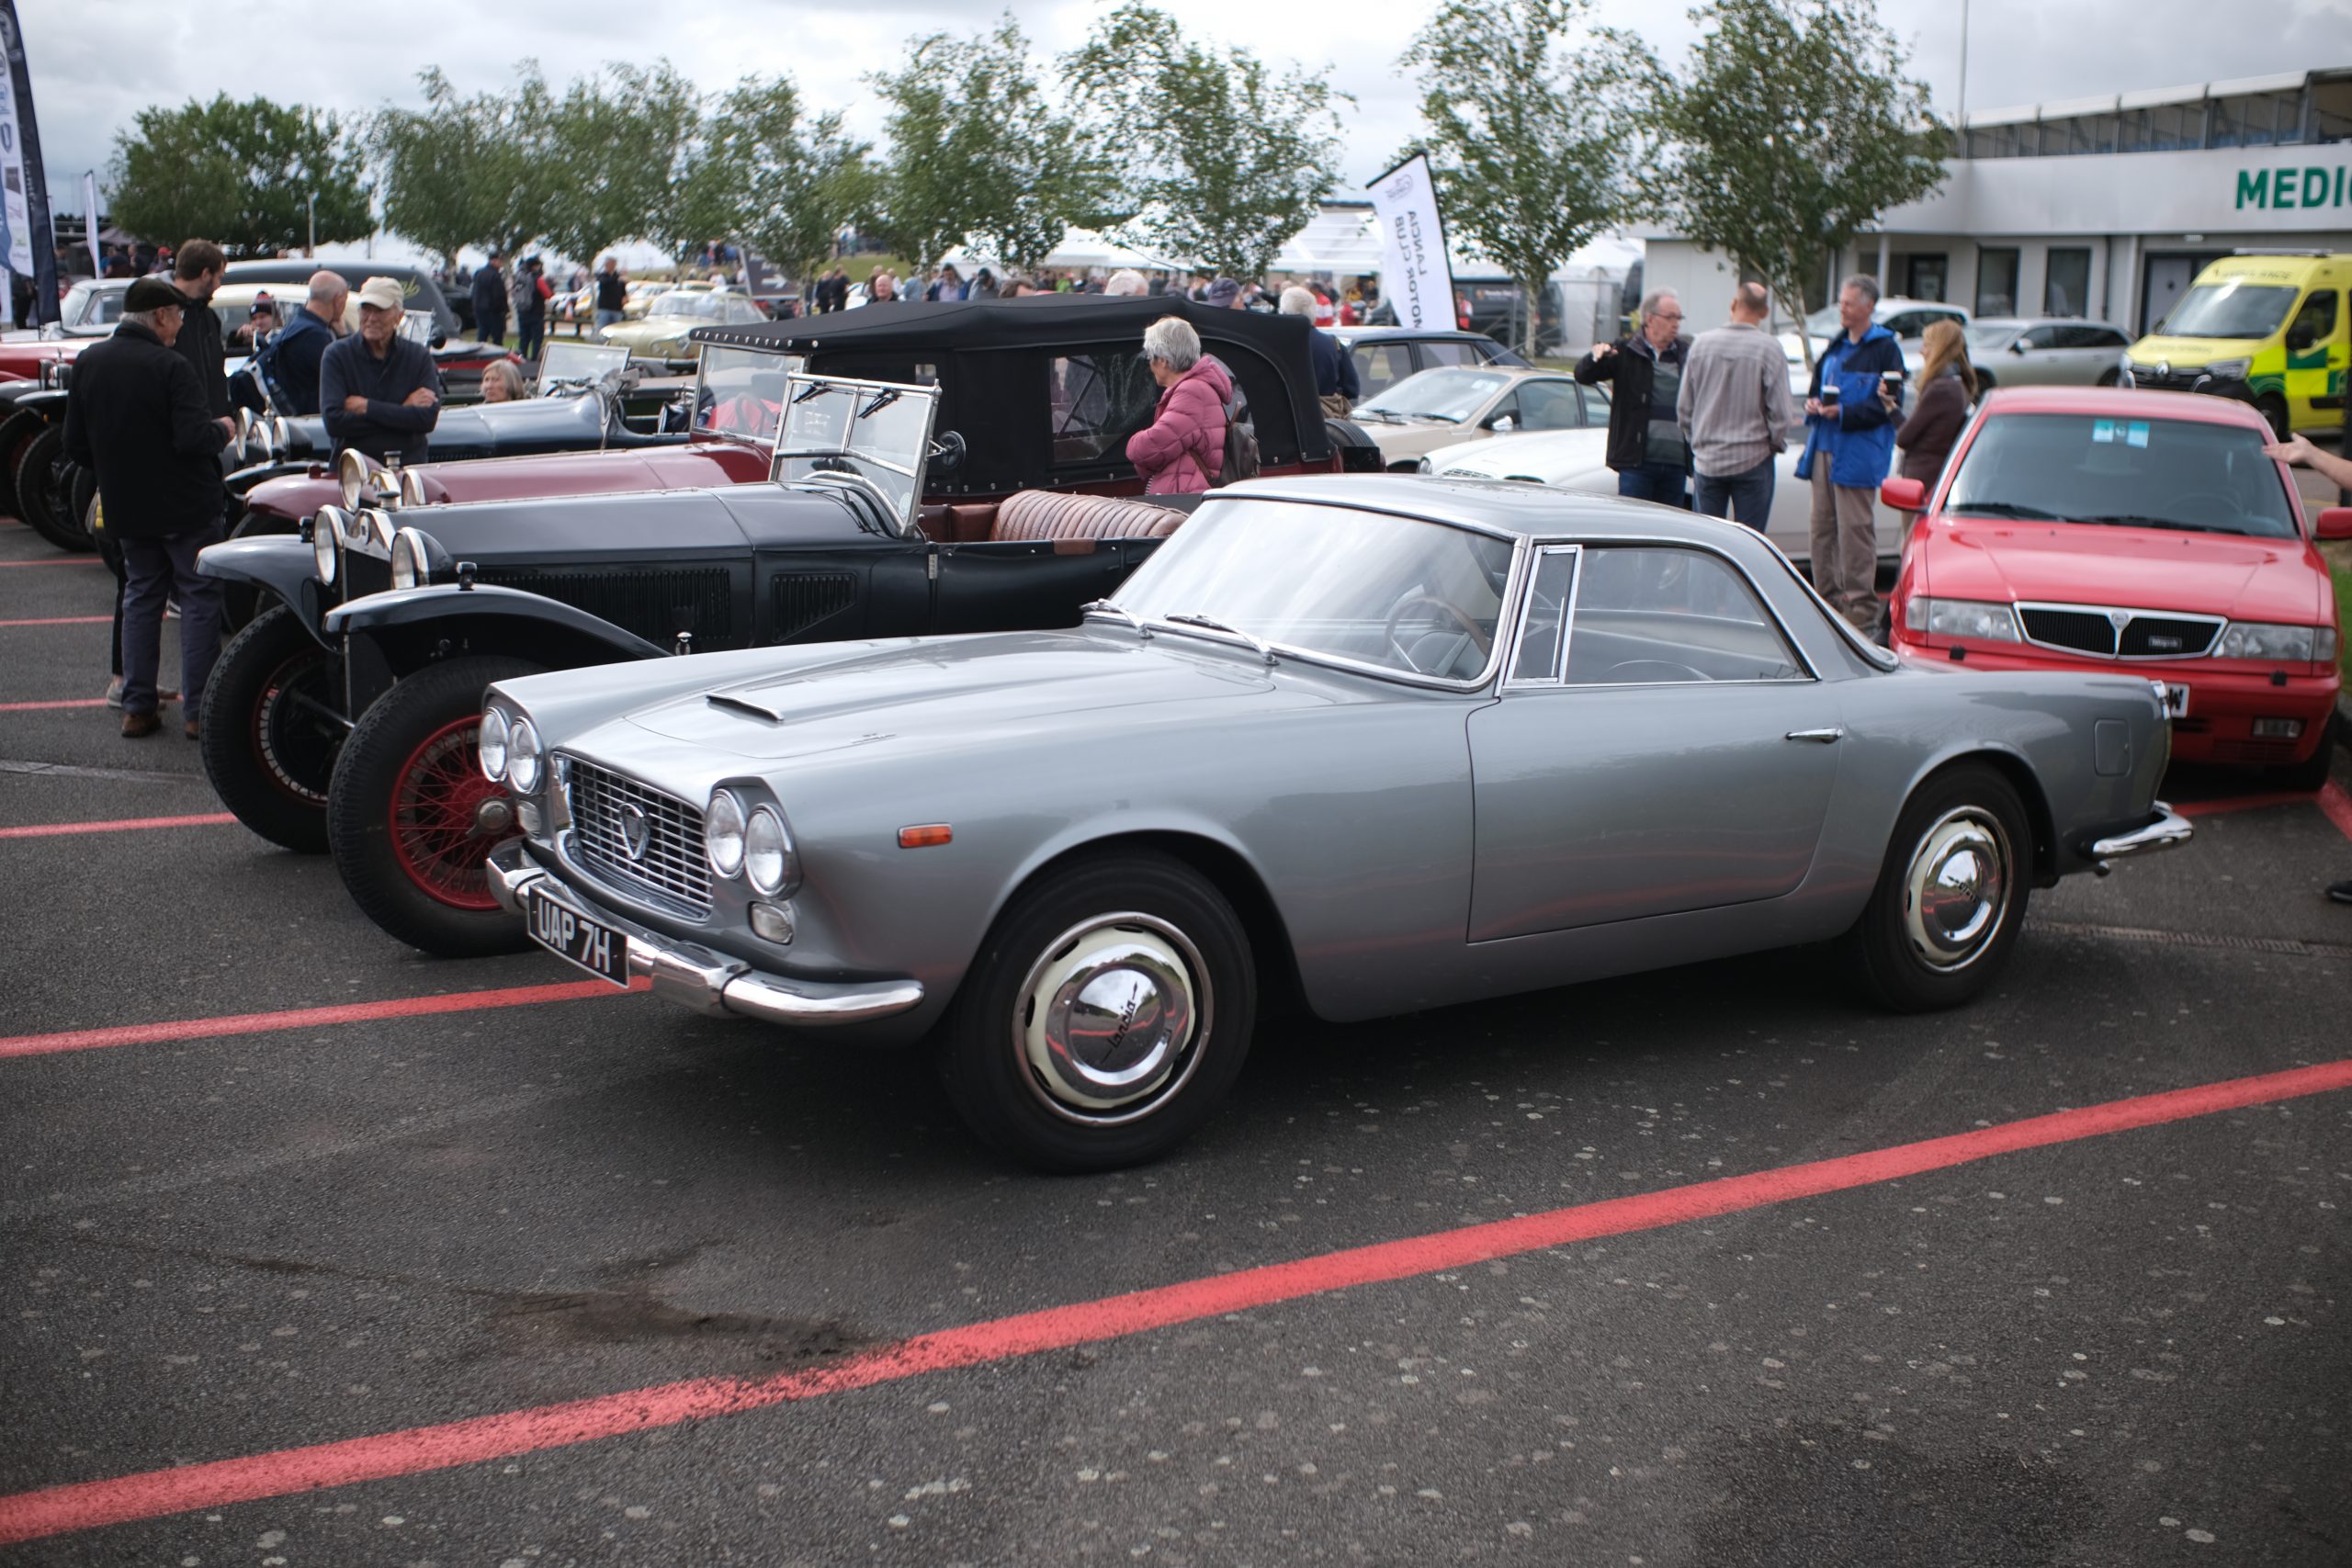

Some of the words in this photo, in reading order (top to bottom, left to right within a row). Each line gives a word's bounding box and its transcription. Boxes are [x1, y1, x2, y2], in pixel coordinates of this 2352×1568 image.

[2235, 165, 2352, 209] MEDI
[538, 897, 575, 951] UAP
[580, 919, 610, 973] 7H
